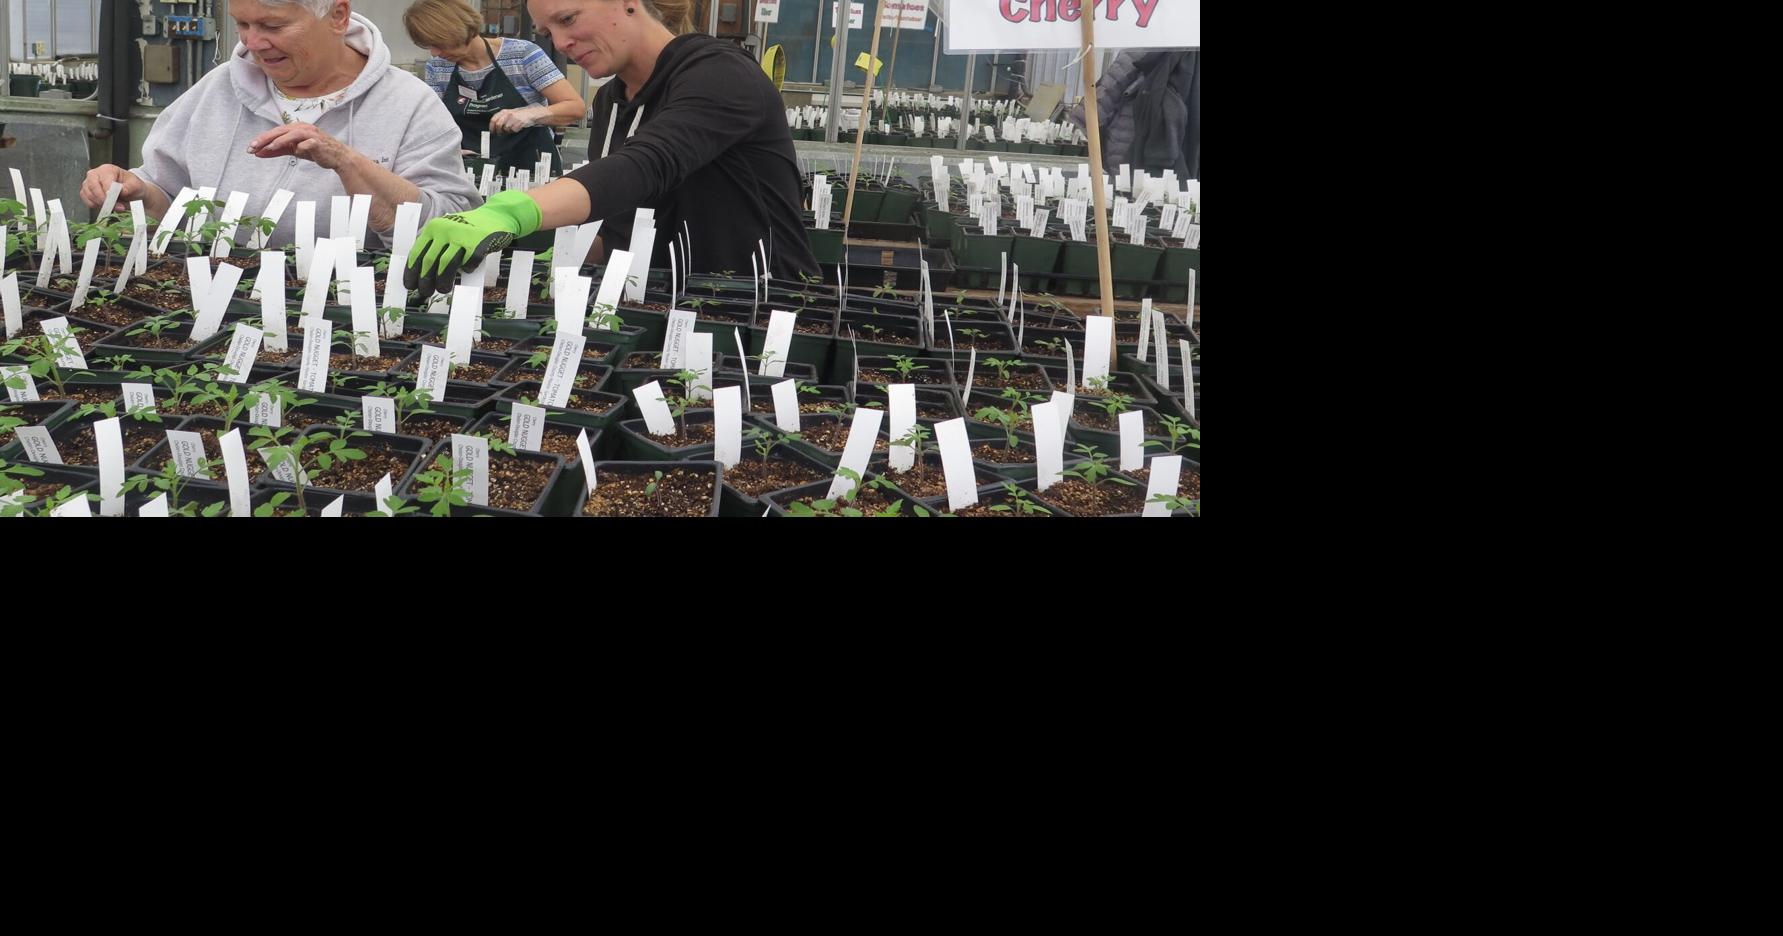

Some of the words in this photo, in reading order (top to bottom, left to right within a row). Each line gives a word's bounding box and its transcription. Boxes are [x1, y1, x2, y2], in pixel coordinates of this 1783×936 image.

[242, 336, 252, 351] GOLD
[563, 340, 573, 356] GOLD
[312, 344, 320, 366] NUGGET
[432, 354, 440, 369] GOLD
[556, 356, 568, 378] NUGGET
[522, 414, 531, 428] GOLD
[31, 434, 44, 452] GOLD
[181, 440, 191, 456] GOLD
[466, 445, 474, 461] GOLD
